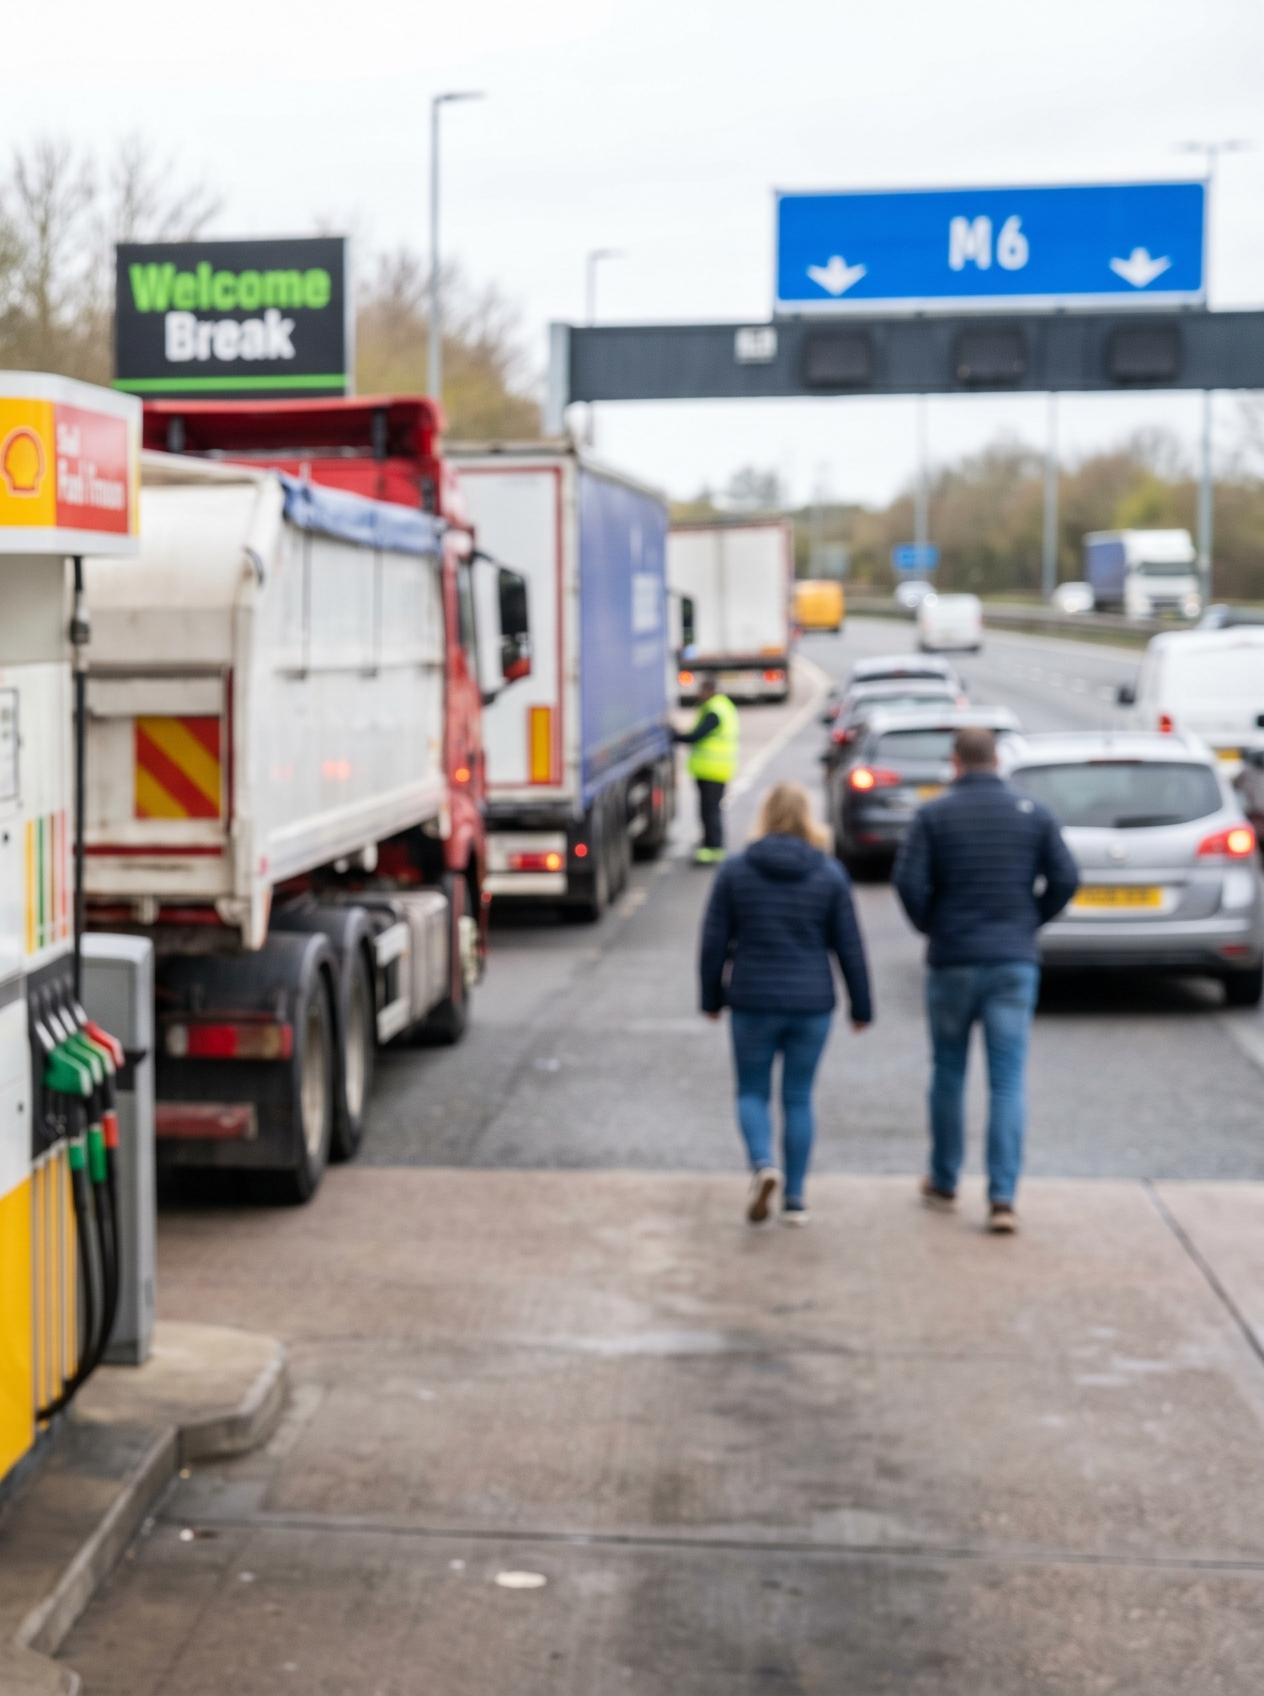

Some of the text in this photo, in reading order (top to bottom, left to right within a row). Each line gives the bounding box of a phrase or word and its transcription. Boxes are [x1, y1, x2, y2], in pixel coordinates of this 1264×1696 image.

[948, 214, 1030, 271] M6
[129, 260, 331, 313] Welcome
[164, 308, 296, 362] Break
